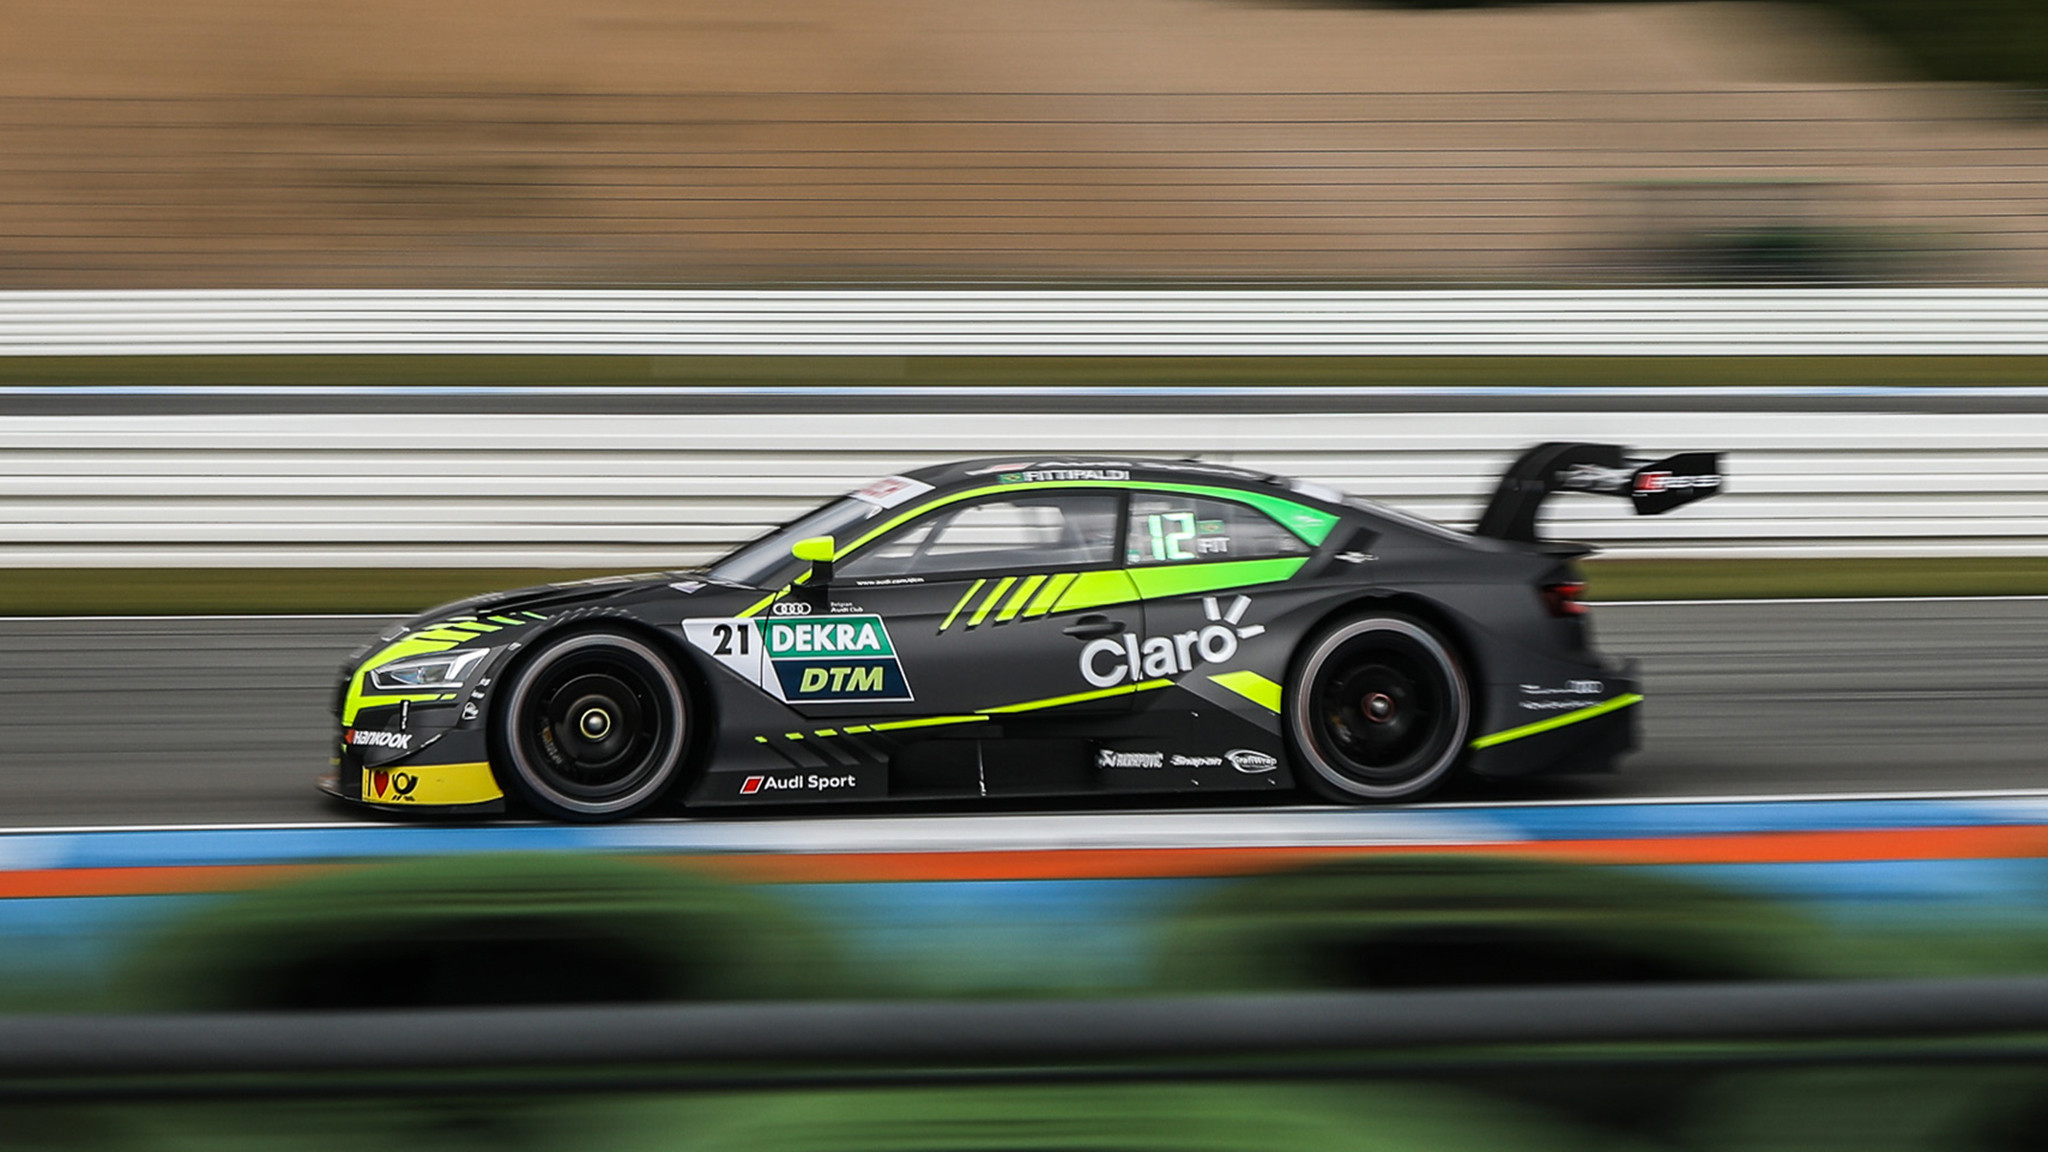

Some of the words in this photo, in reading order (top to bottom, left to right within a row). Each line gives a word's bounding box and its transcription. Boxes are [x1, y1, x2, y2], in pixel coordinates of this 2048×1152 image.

[1023, 470, 1130, 481] FITTIPALDI
[1148, 512, 1196, 560] 12
[713, 624, 750, 655] 21
[771, 622, 881, 652] DEKRA
[1079, 624, 1237, 688] Claro
[799, 667, 884, 692] DTM
[764, 776, 804, 789] Audi
[808, 775, 855, 790] Sport
